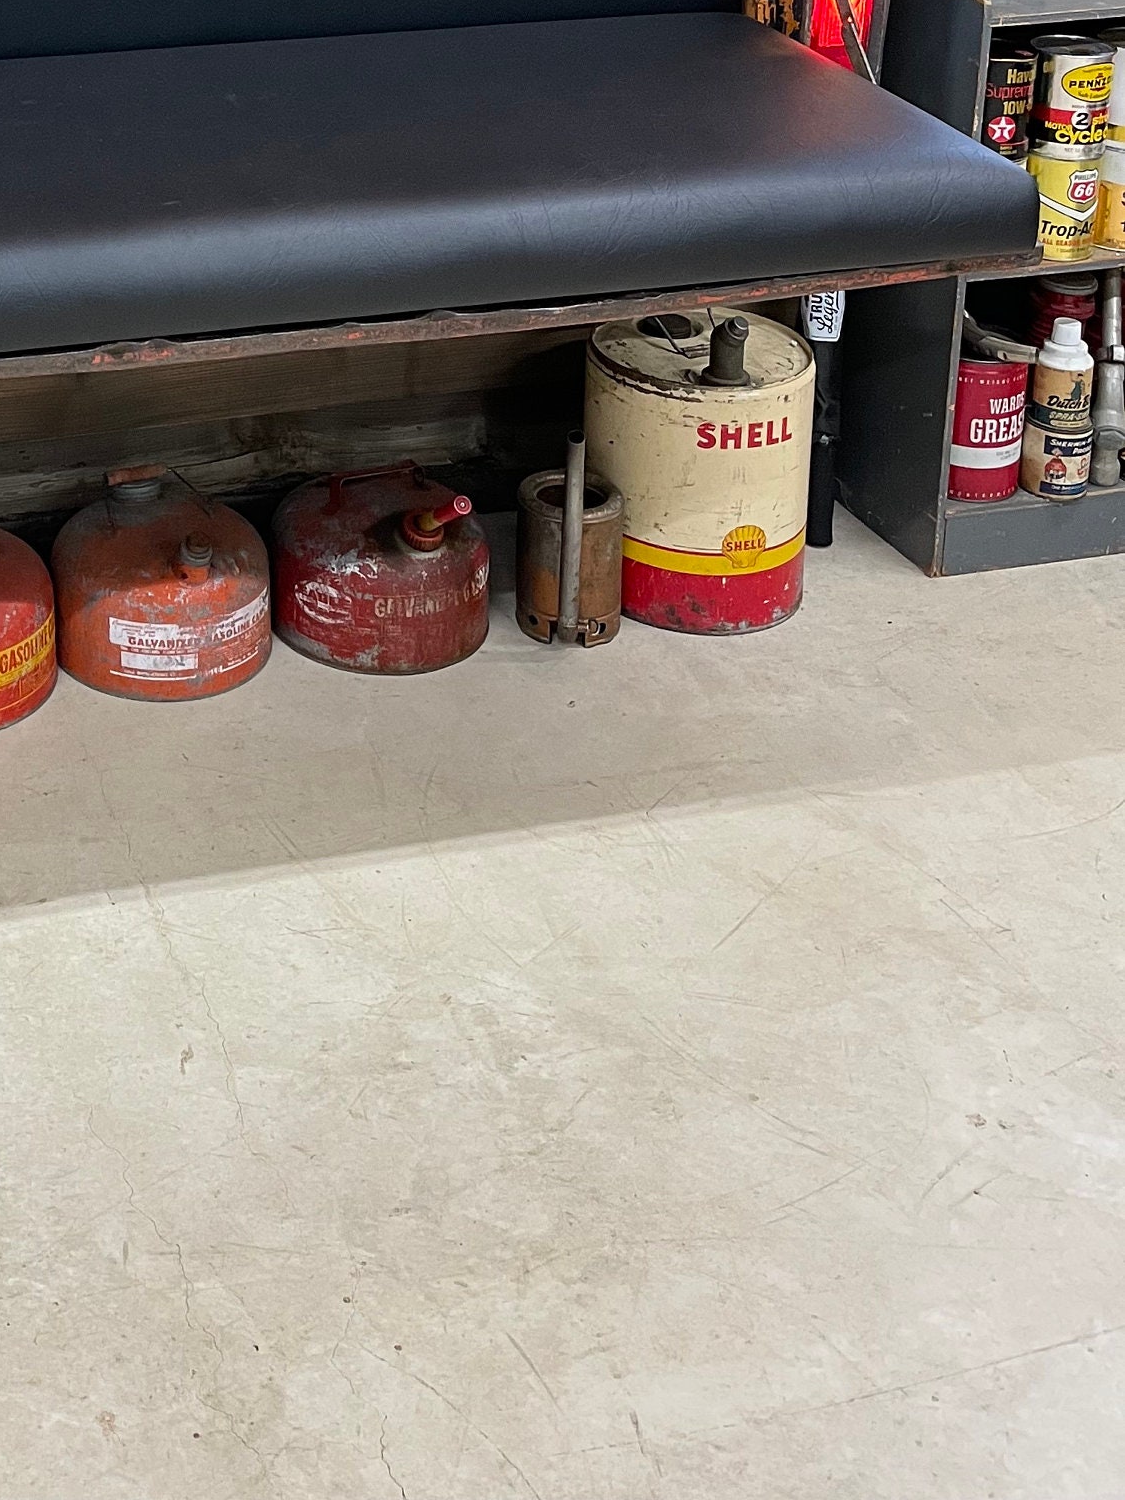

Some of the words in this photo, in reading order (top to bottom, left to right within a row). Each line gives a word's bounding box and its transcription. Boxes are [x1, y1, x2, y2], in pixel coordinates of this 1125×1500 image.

[1044, 121, 1073, 133] MOTOR
[1075, 112, 1089, 126] 2
[1055, 123, 1103, 146] cycle
[1074, 182, 1095, 199] 66
[809, 292, 823, 322] TRU
[817, 290, 839, 334] Legen
[1046, 395, 1082, 410] Dutch
[696, 416, 793, 451] SHELL
[969, 408, 1026, 444] GREAS
[725, 537, 766, 552] SHELL
[0, 624, 48, 674] GASOLINE
